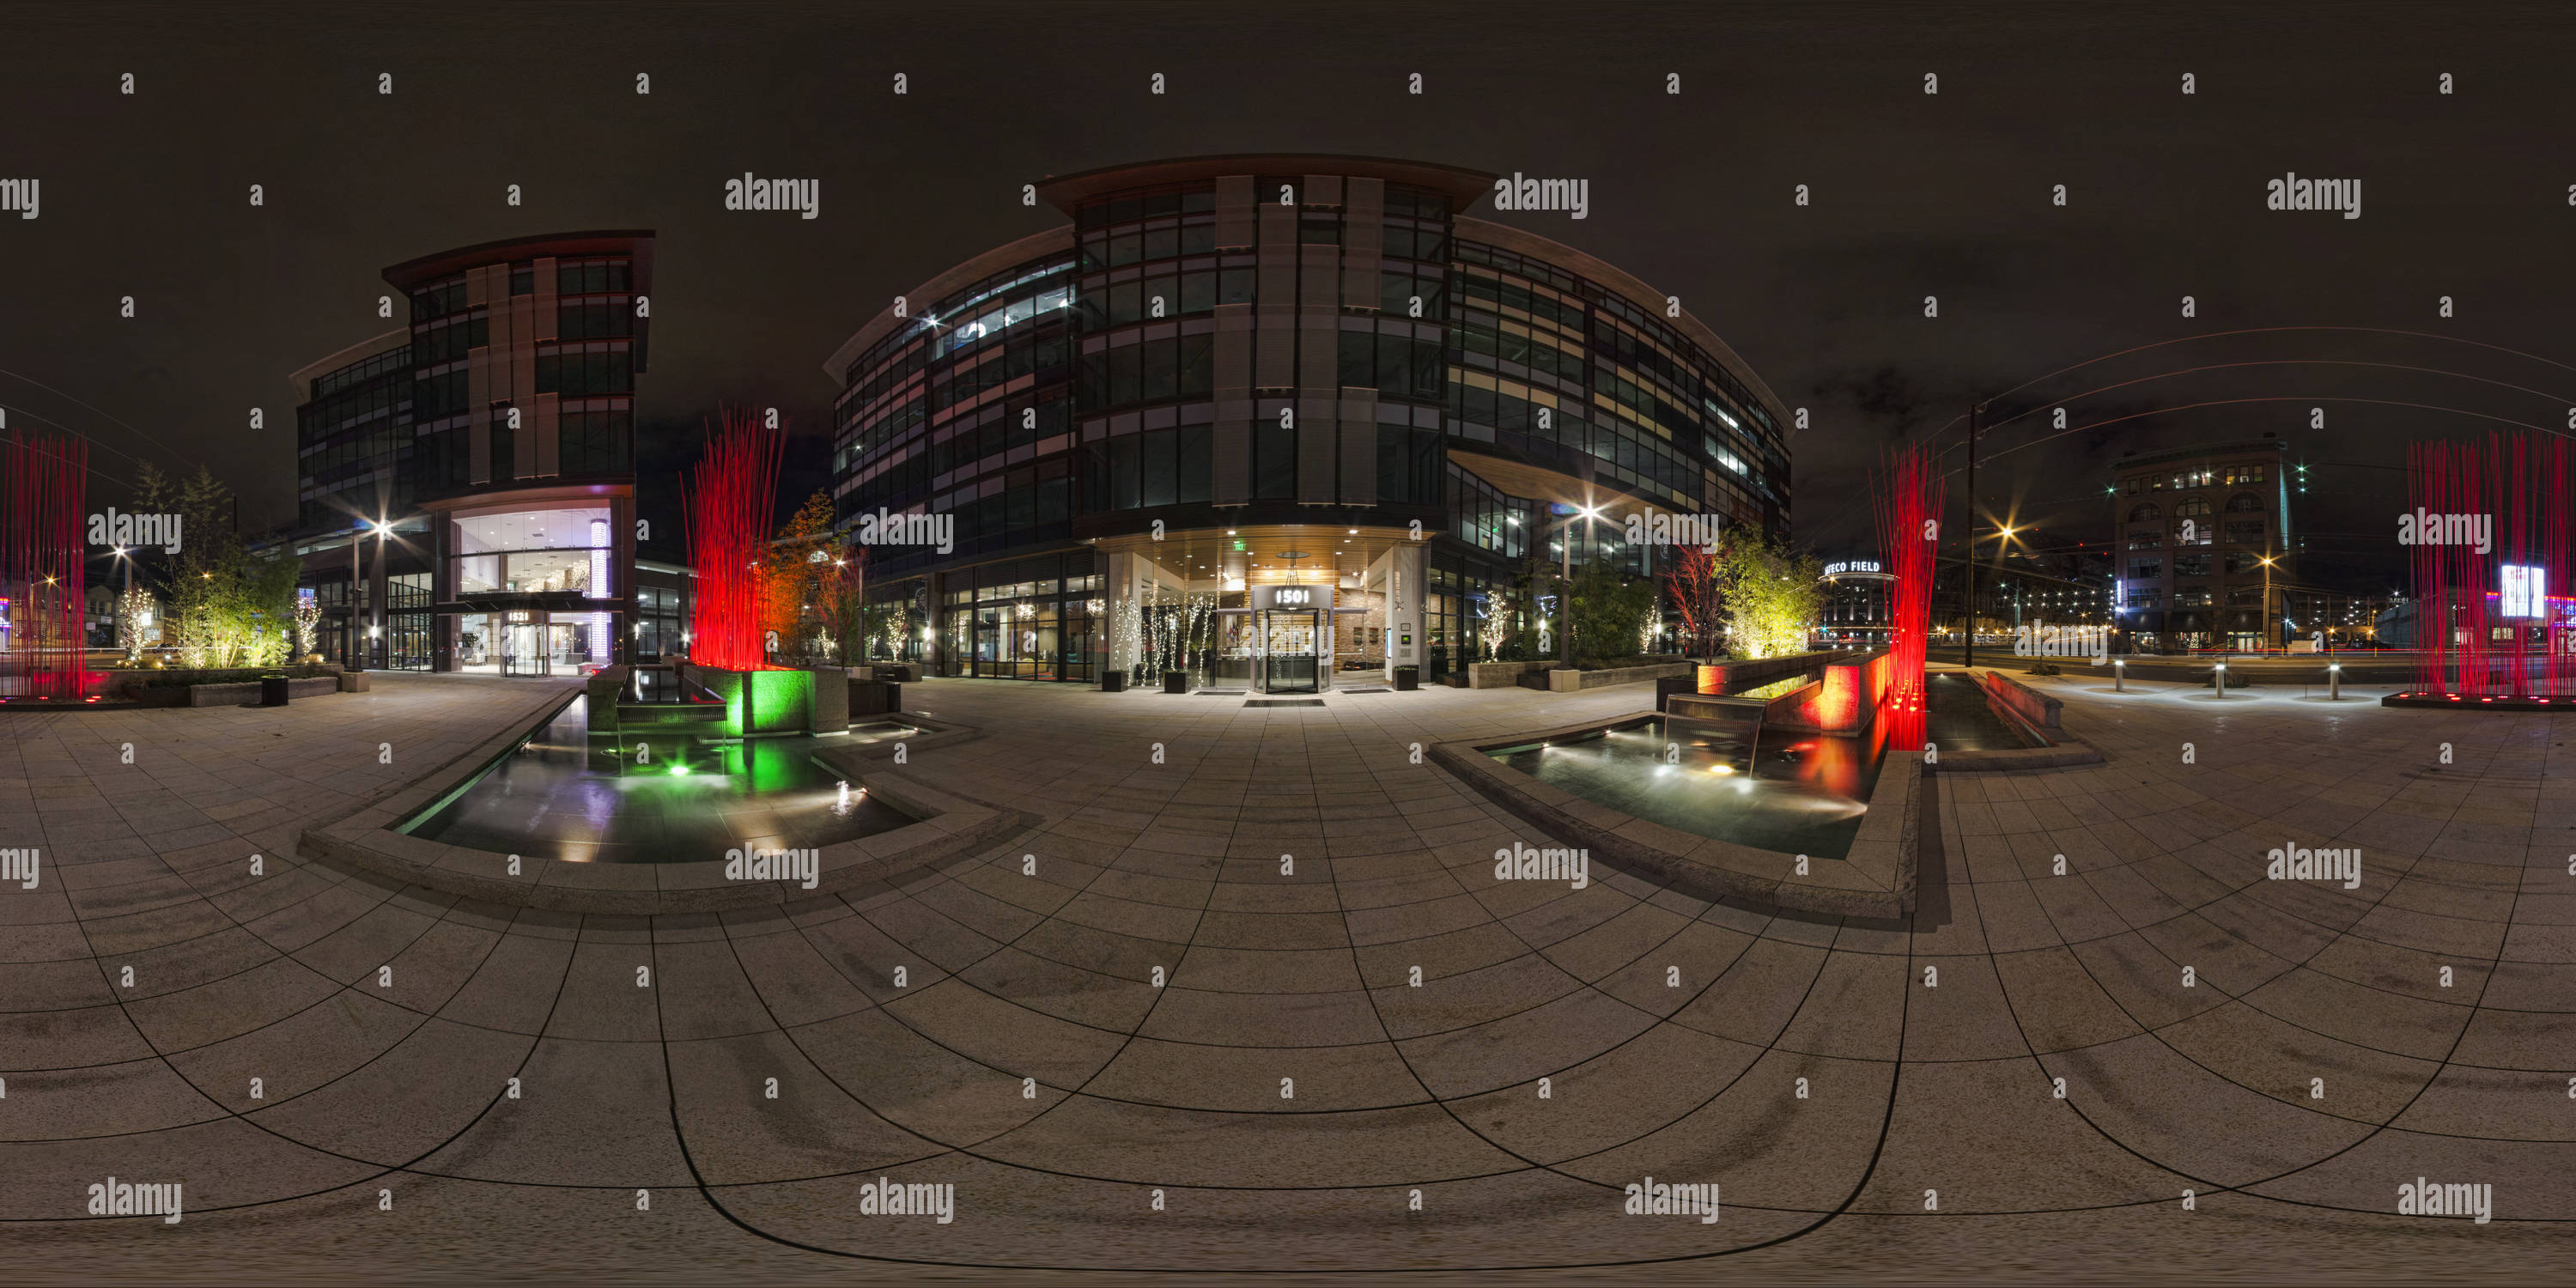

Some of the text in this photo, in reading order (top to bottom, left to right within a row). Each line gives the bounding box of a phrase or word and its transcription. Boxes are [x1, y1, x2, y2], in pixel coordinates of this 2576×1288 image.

[1850, 561, 1880, 572] FIELD
[1276, 590, 1309, 604] 1501
[509, 612, 529, 621] 1521
